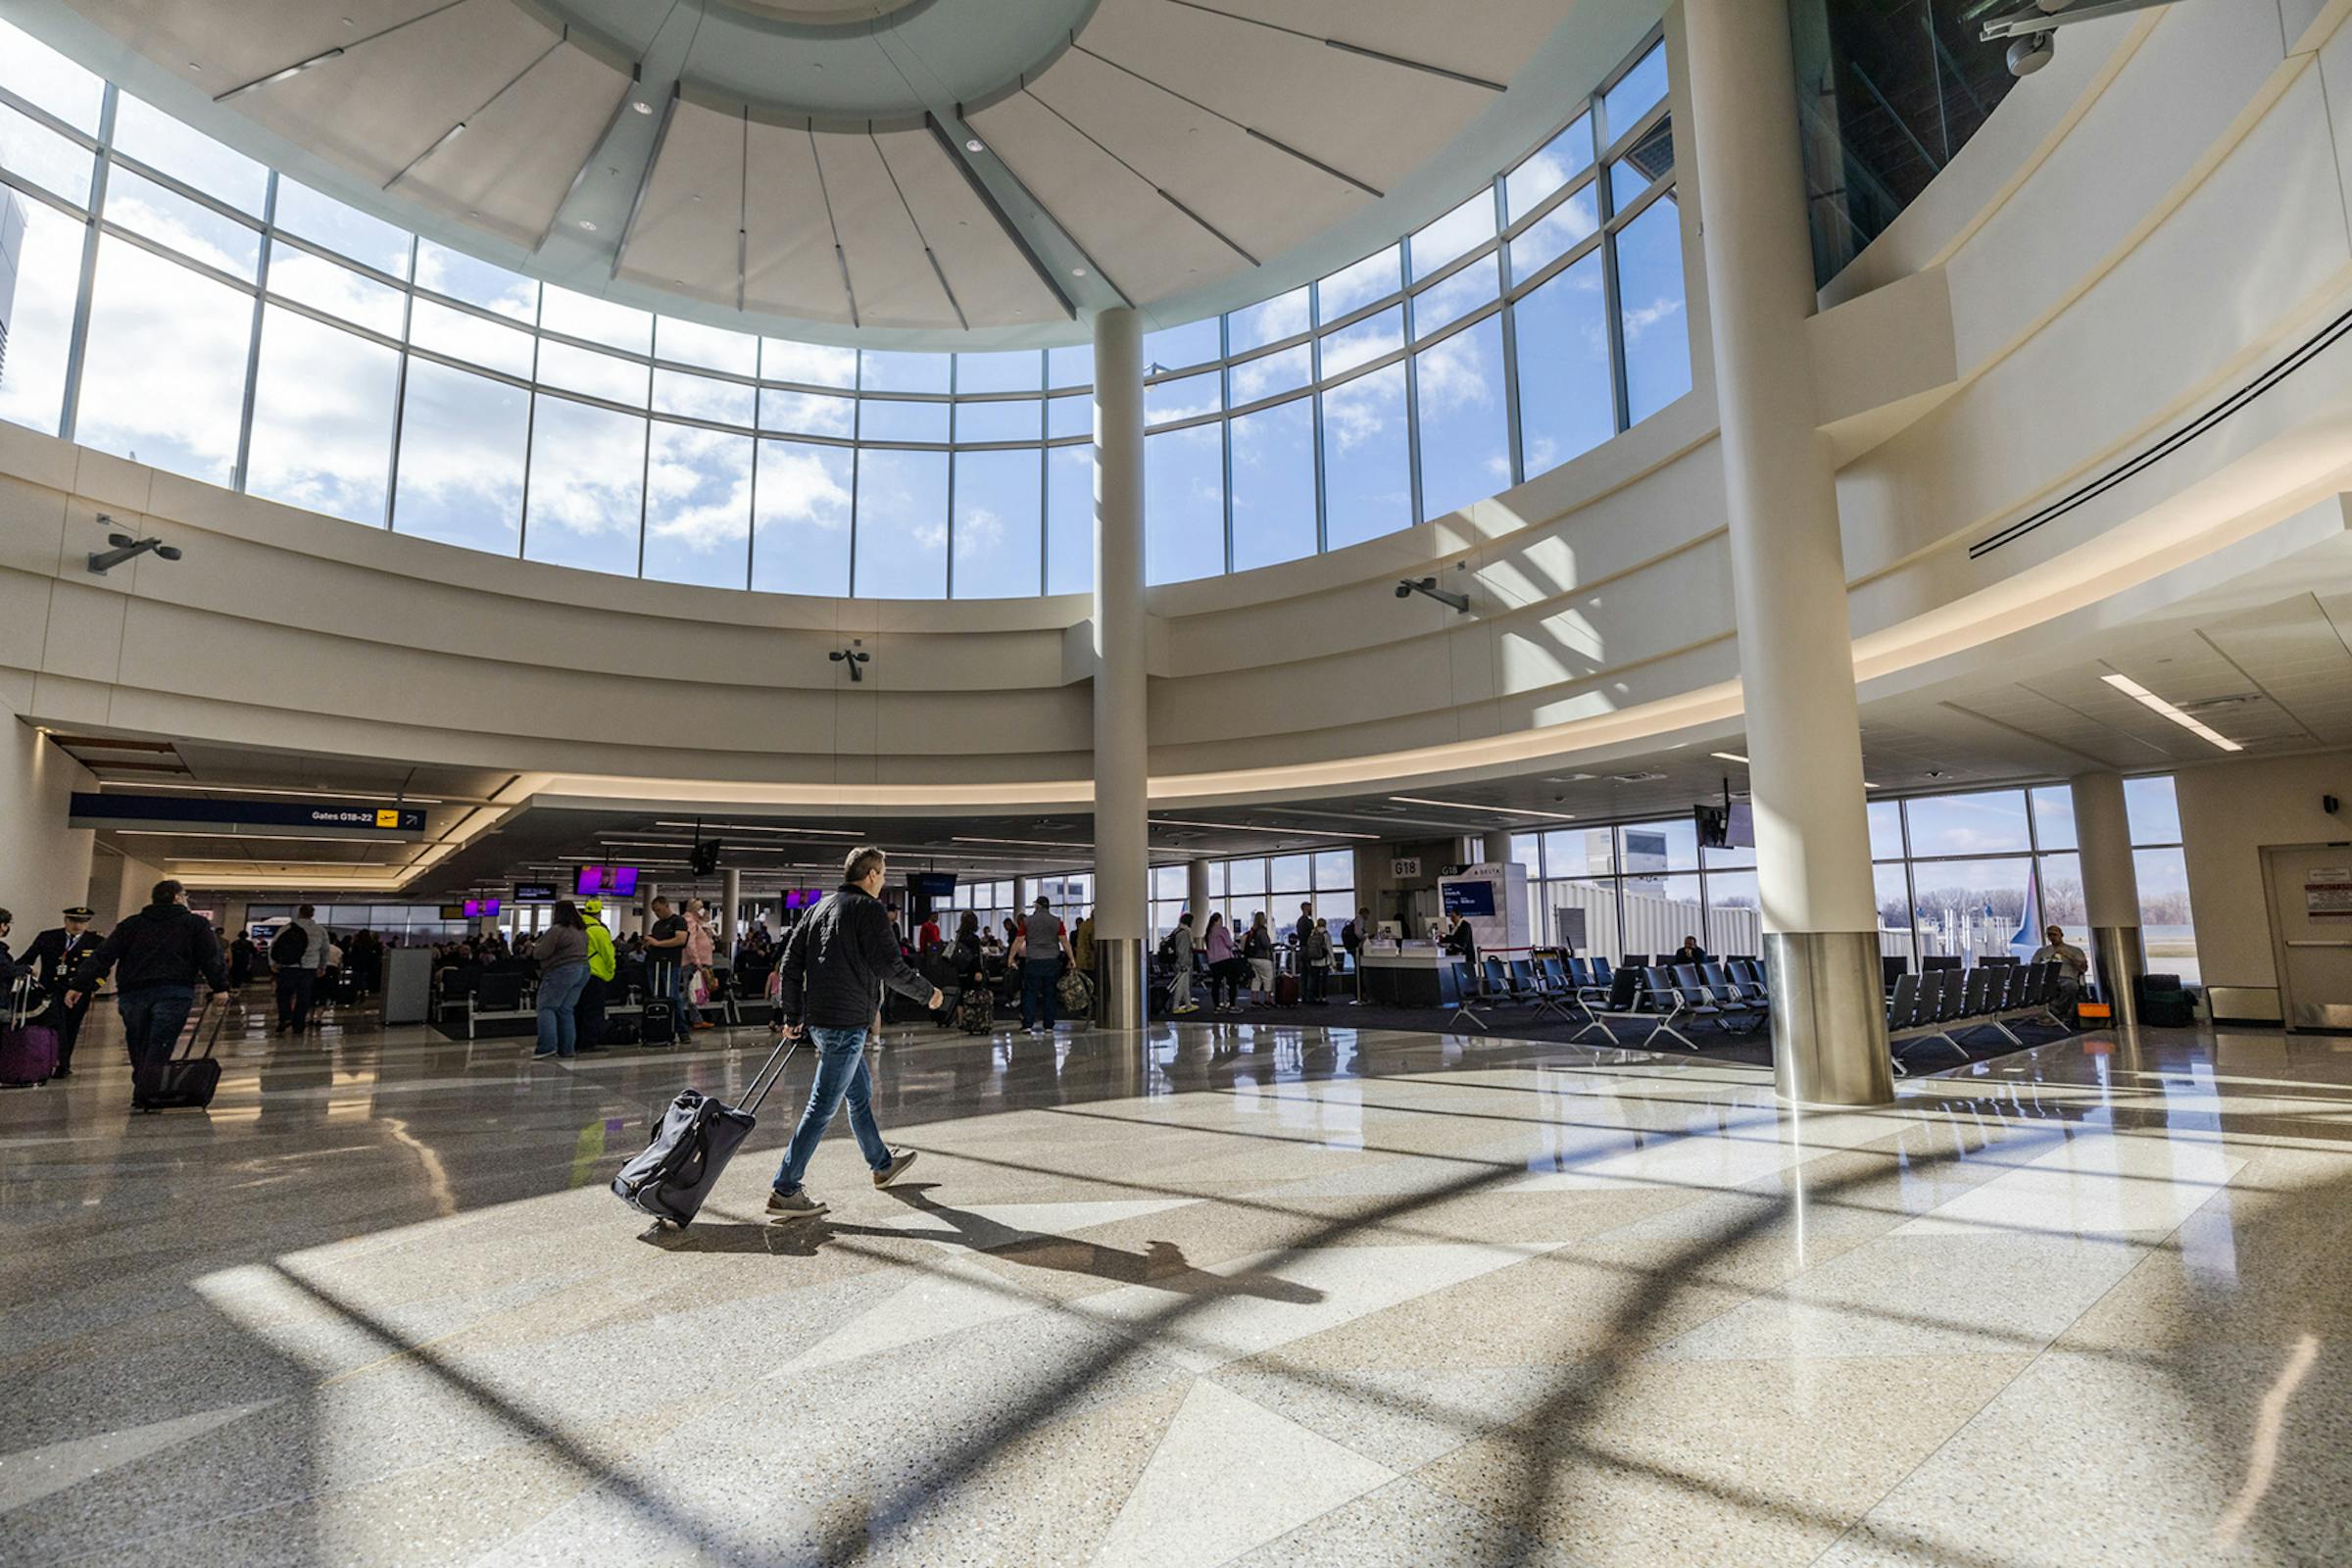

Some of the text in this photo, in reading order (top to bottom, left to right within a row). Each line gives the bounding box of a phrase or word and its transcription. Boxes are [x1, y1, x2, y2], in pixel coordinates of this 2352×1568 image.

[312, 810, 372, 821] Gates G18-22
[1395, 861, 1415, 874] G18
[1442, 865, 1458, 875] G18
